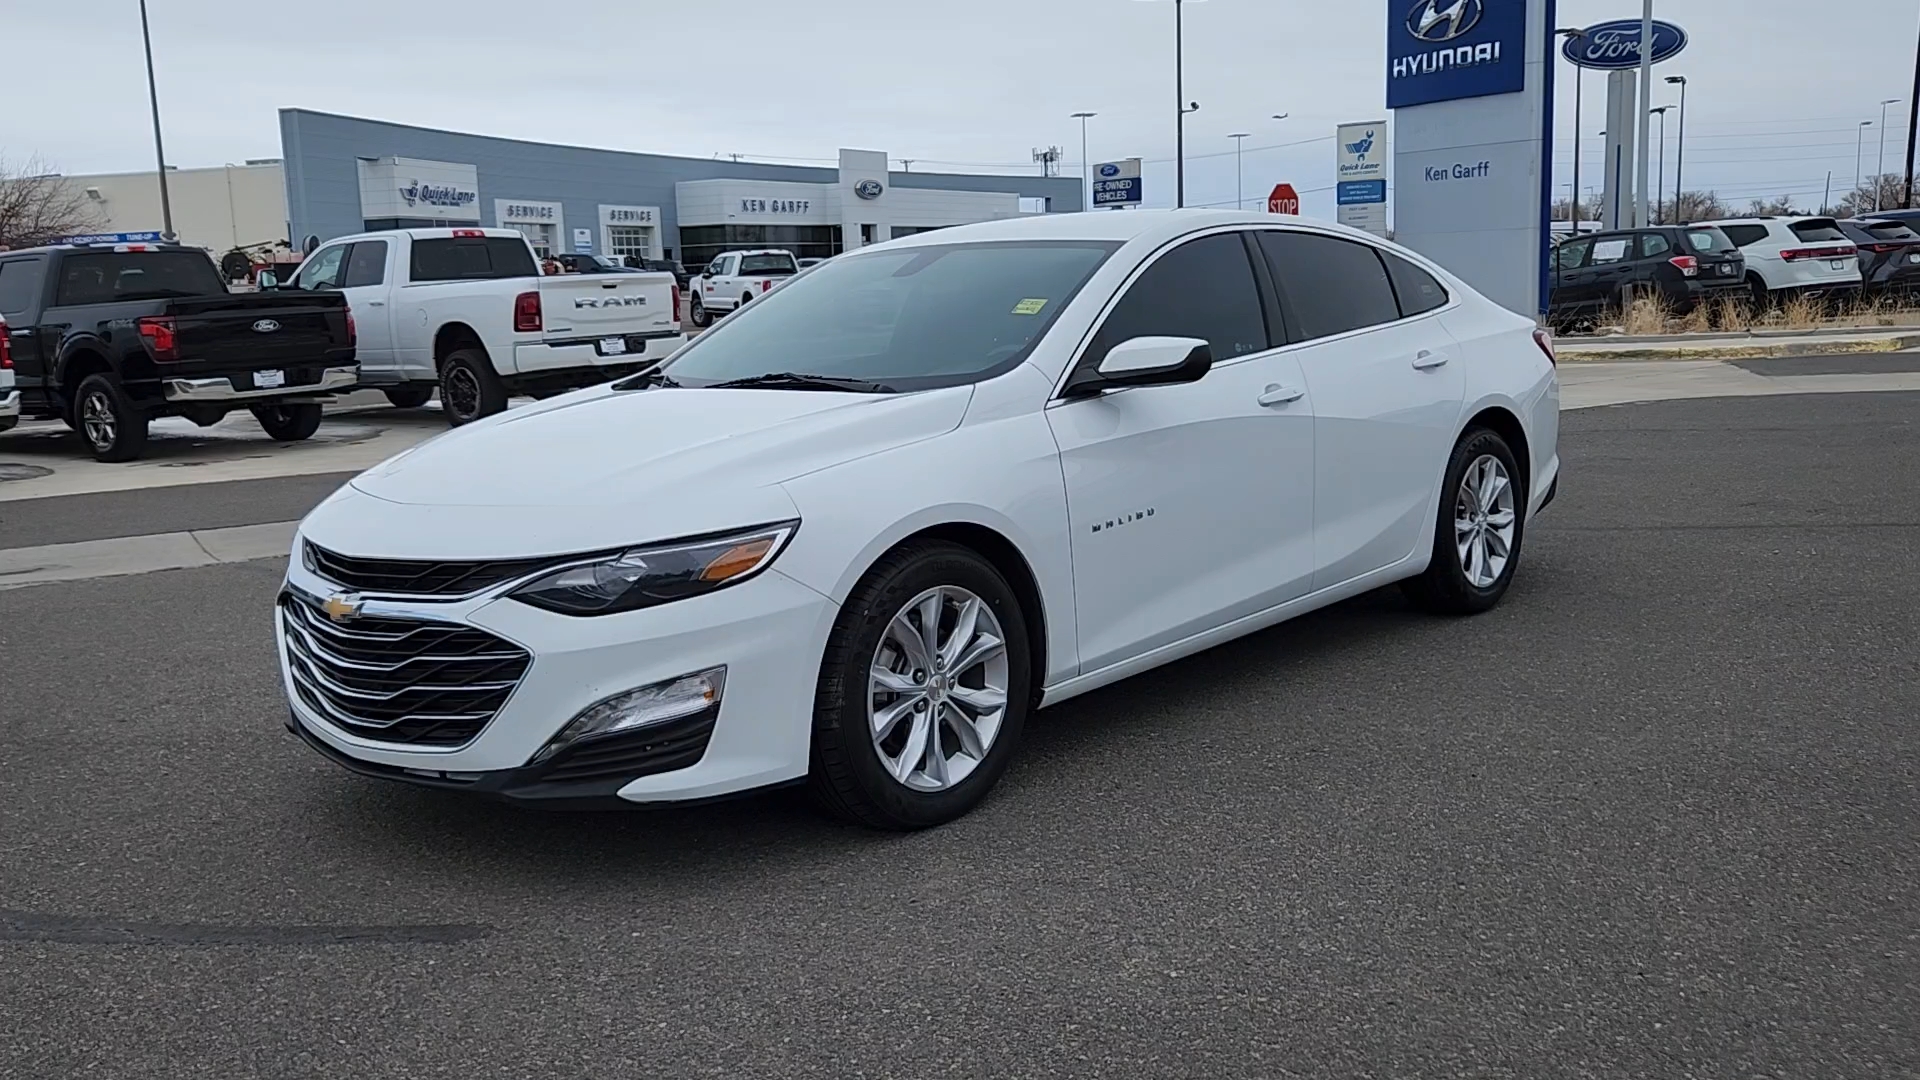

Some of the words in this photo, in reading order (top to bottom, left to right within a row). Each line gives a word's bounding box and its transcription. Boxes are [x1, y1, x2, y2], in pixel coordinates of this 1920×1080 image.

[1587, 29, 1659, 59] Ford
[1393, 41, 1500, 78] HYUNDAI
[1340, 163, 1360, 172] Quick
[1360, 162, 1380, 170] Lane
[1424, 166, 1448, 181] Ken
[1452, 161, 1490, 179] Garff
[421, 185, 450, 201] Quick
[451, 187, 476, 202] Lane
[1096, 190, 1127, 202] VEHICLES
[507, 204, 553, 219] SERVICE
[742, 199, 766, 213] KEN
[771, 200, 809, 214] GARFF
[1270, 199, 1297, 213] STOP
[610, 209, 652, 222] SERVICE
[126, 233, 153, 241] TUNE-UP
[574, 296, 647, 309] RAM
[1091, 507, 1155, 533] MALIBU
